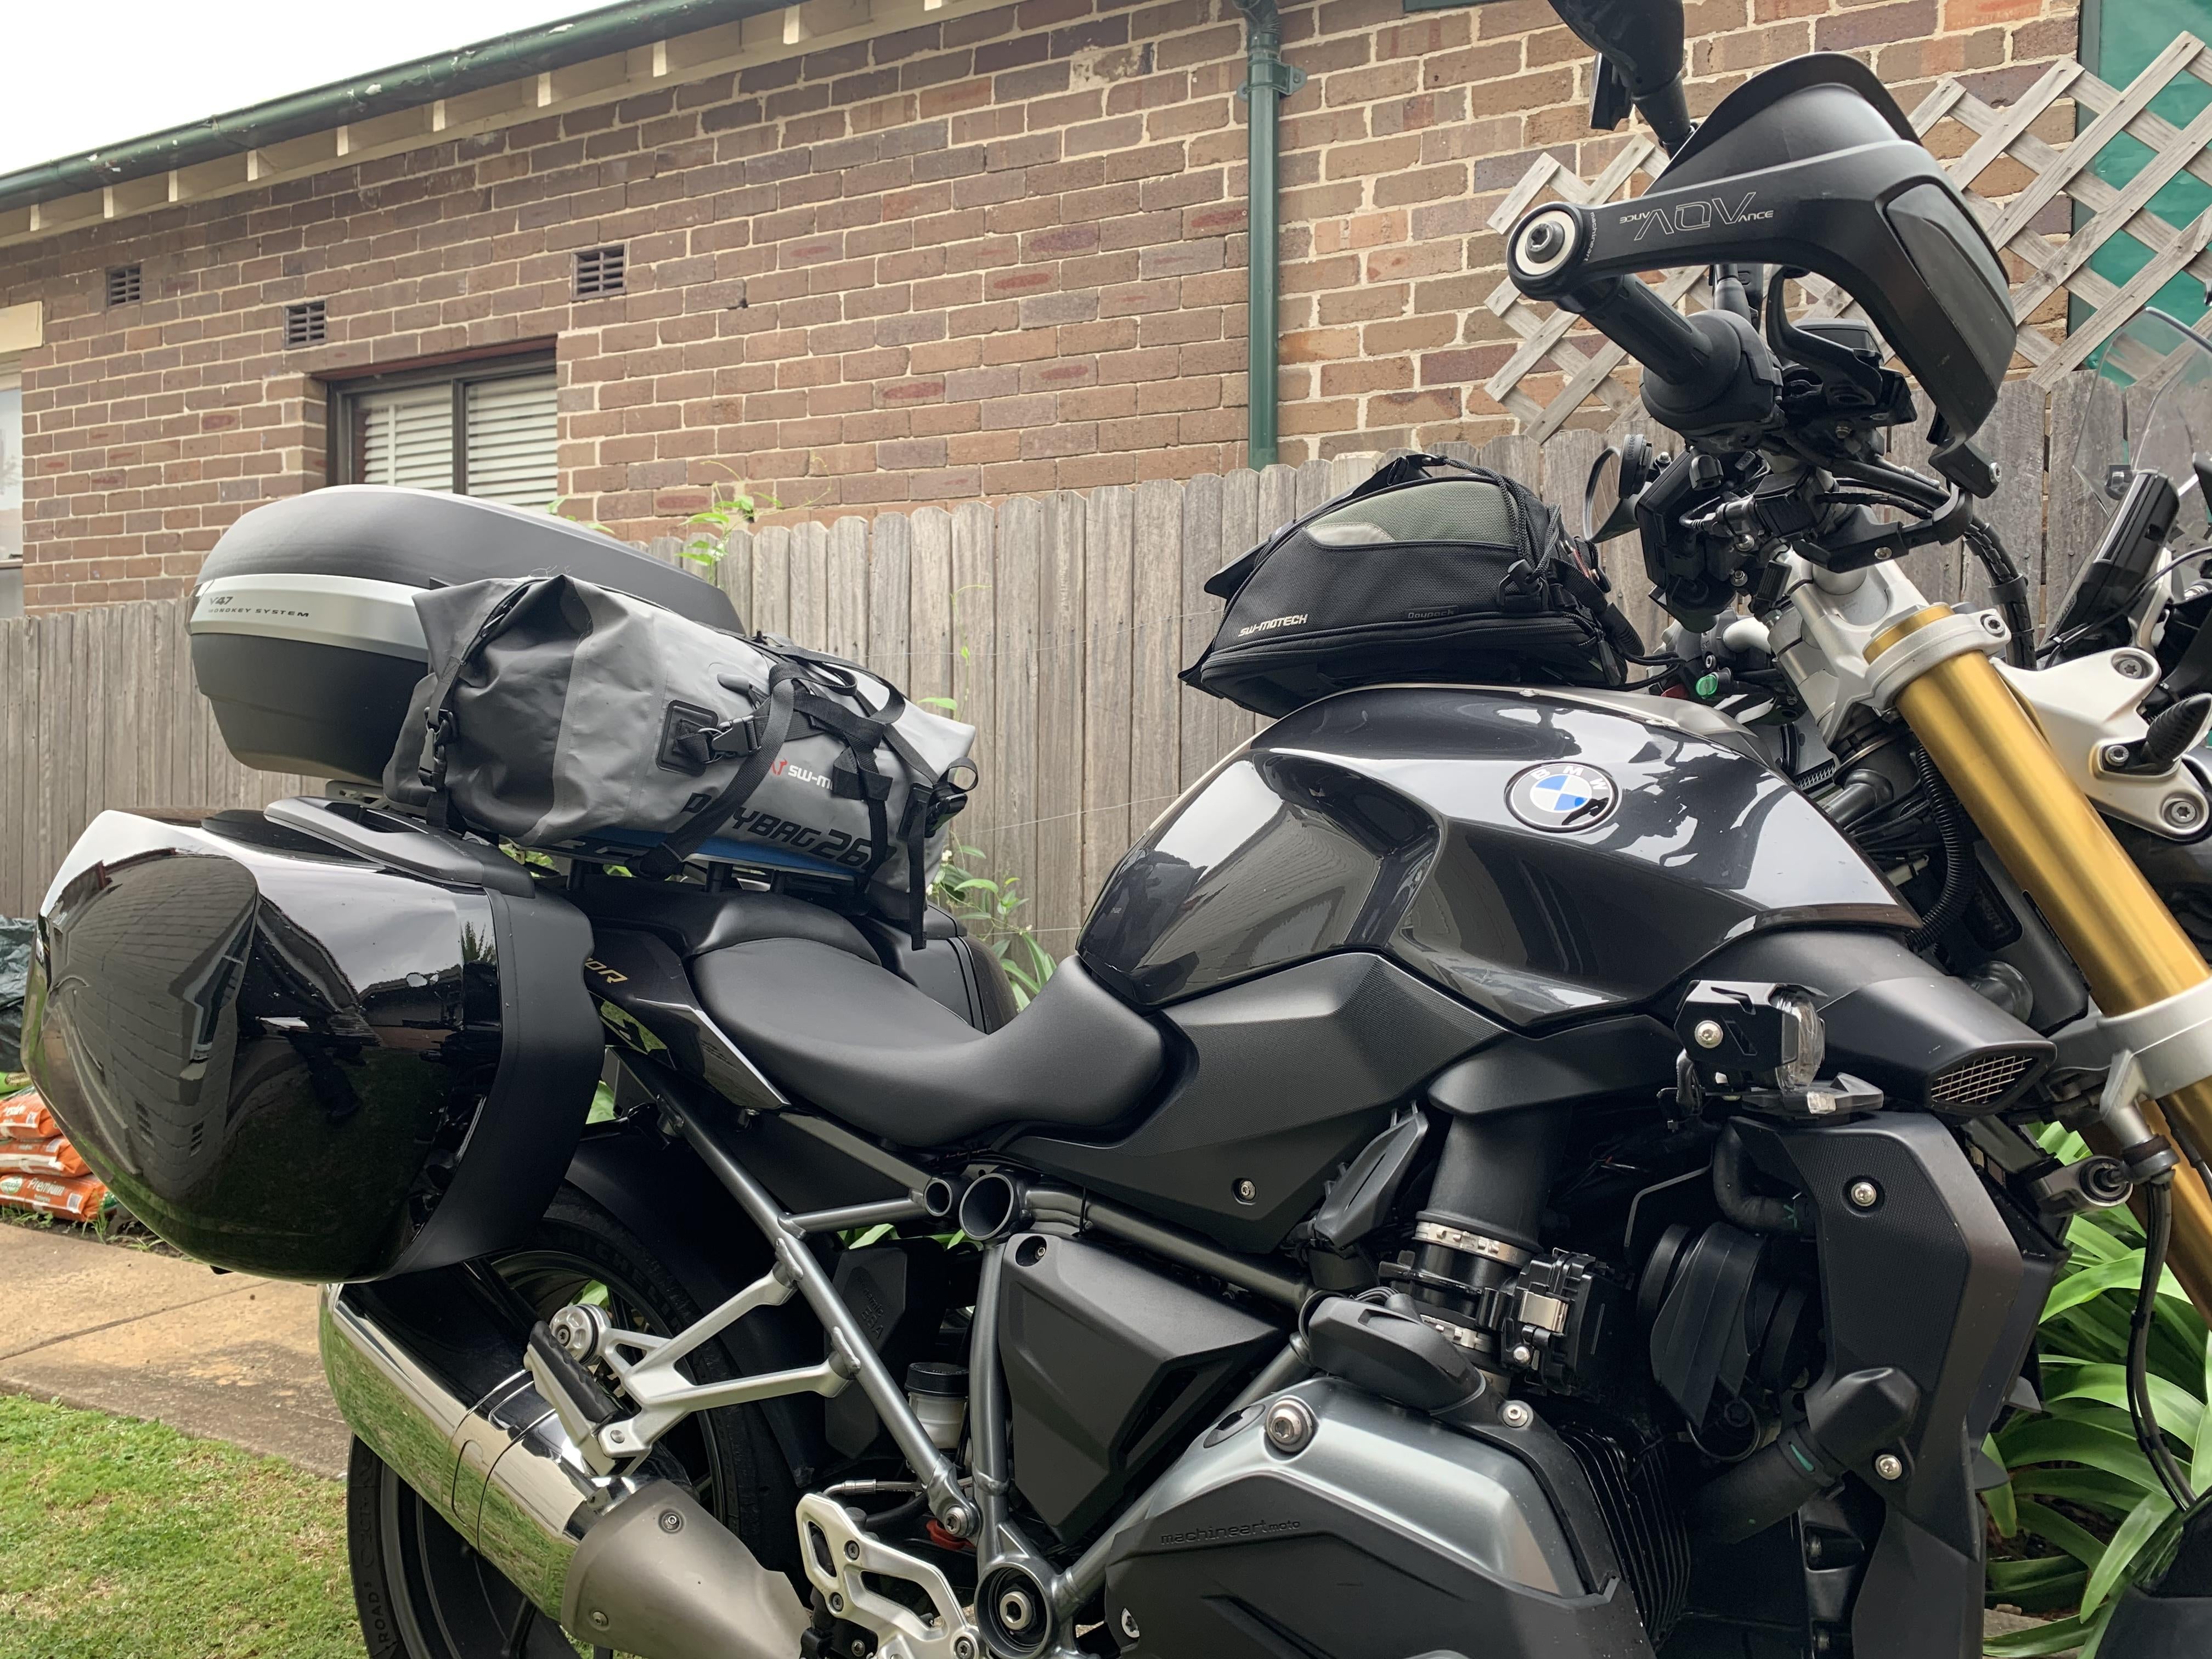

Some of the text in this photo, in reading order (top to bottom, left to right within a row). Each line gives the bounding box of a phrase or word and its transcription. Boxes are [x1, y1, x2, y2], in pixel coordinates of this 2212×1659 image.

[1583, 212, 1597, 261] machineart
[210, 596, 233, 605] V47
[255, 608, 309, 617] SYSTEM
[1238, 613, 1308, 637] SW-MOTECH
[1530, 765, 1609, 790] BMW
[368, 1592, 391, 1643] ROAD
